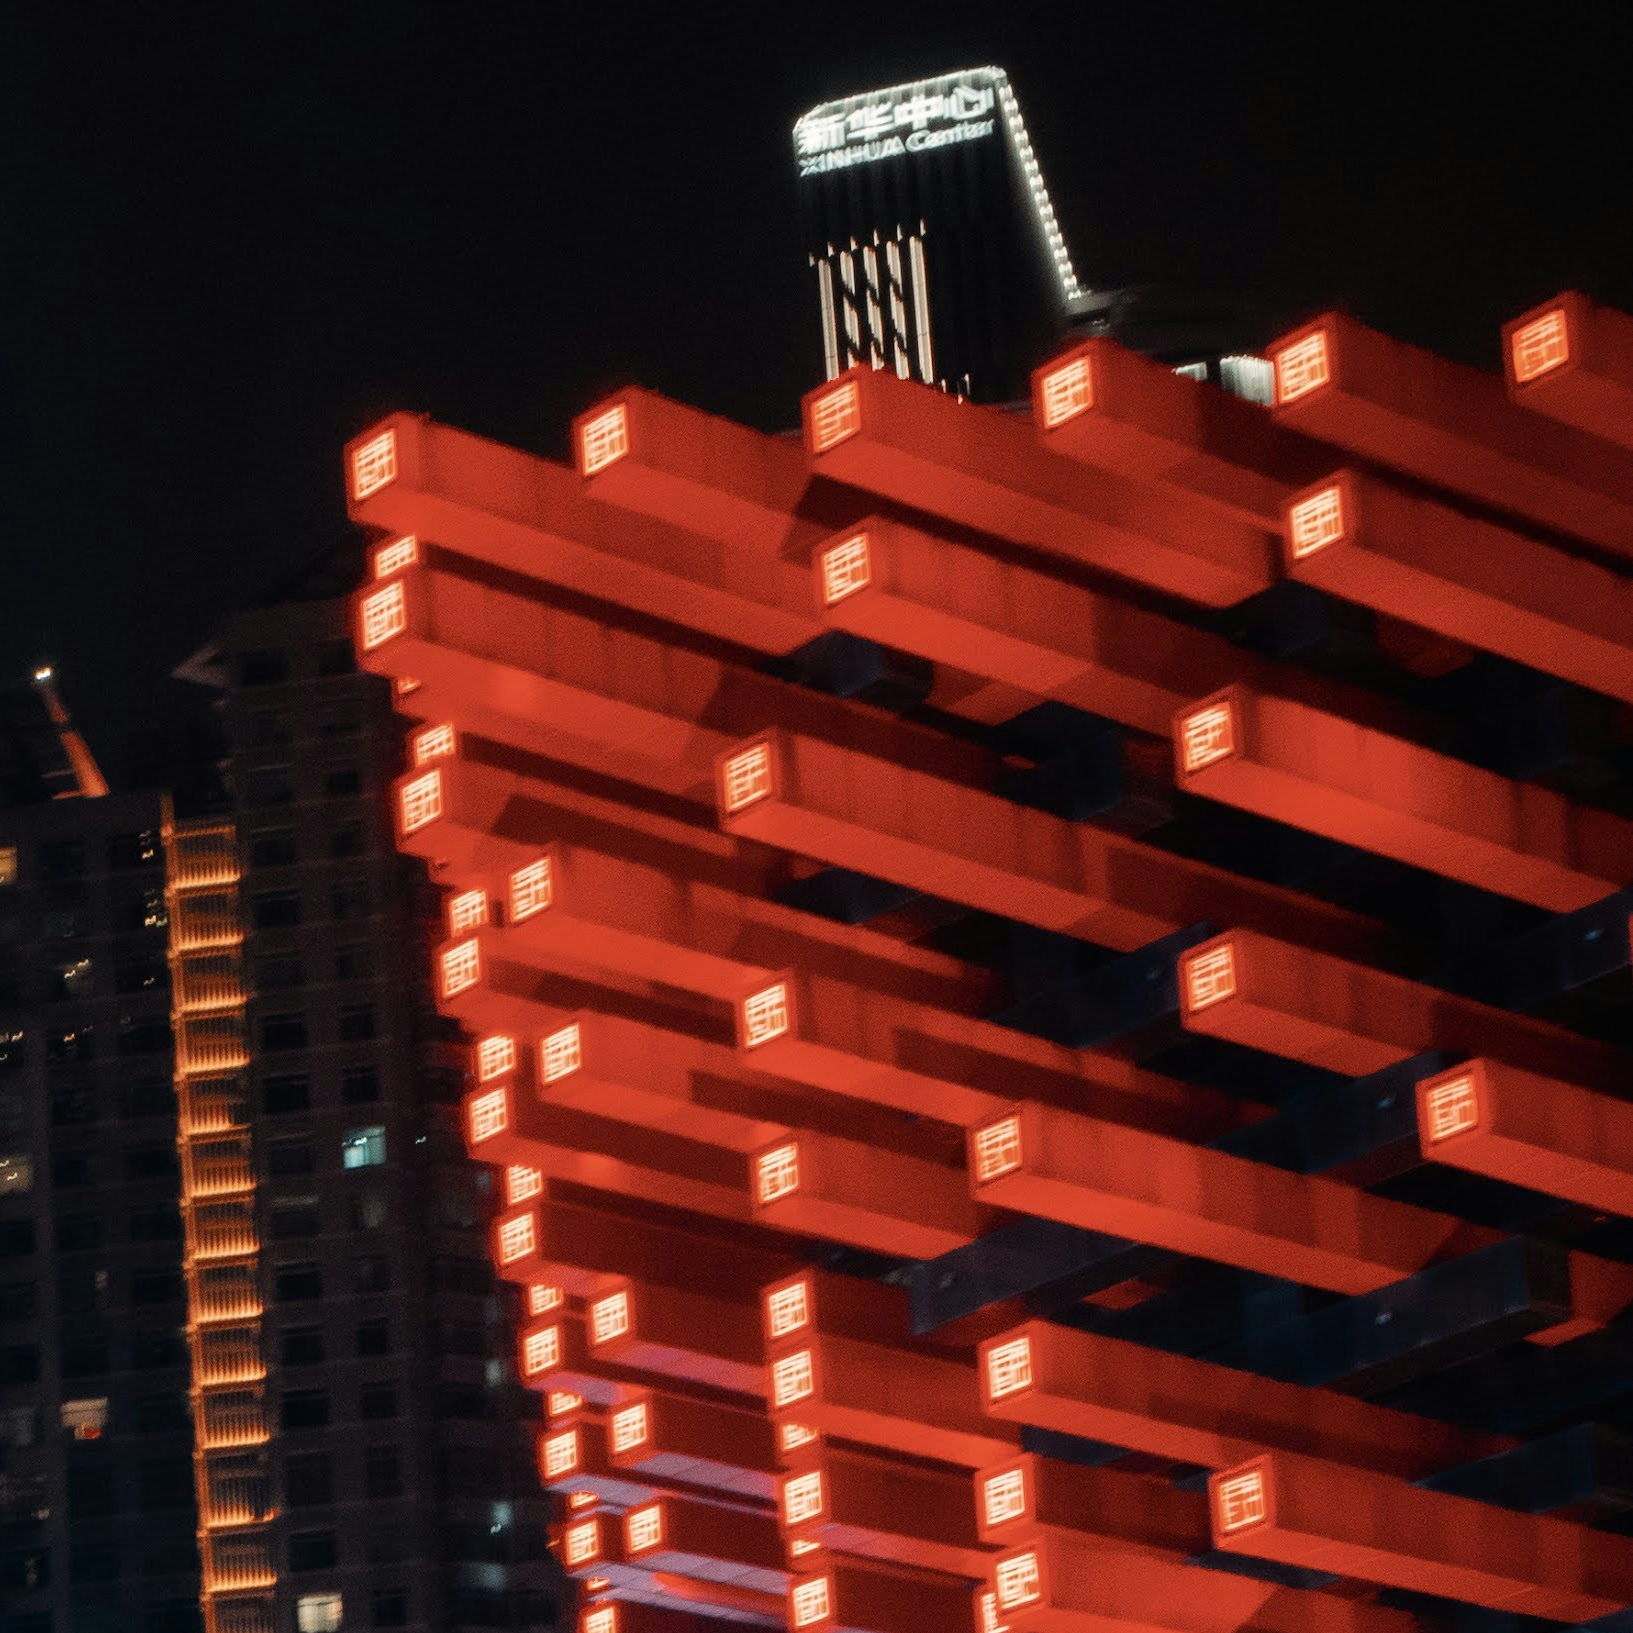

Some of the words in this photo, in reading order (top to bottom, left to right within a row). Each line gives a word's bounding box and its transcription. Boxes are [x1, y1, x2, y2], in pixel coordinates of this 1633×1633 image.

[798, 86, 995, 153] 新华中心
[799, 135, 906, 177] XINHUA
[906, 119, 995, 152] Center
